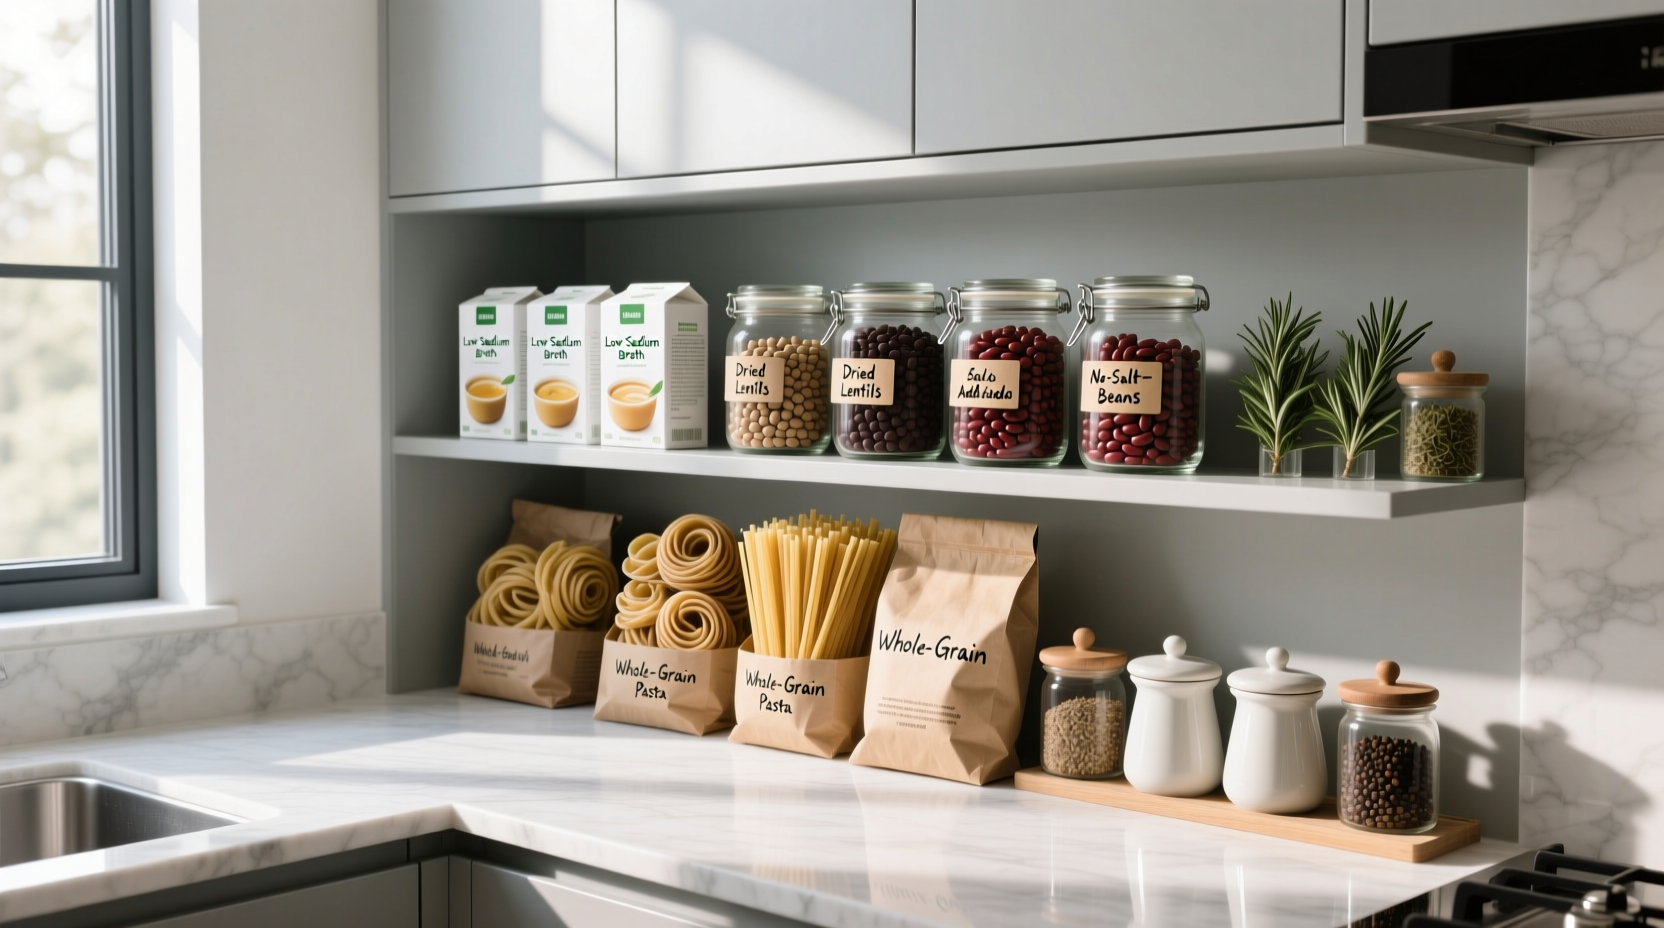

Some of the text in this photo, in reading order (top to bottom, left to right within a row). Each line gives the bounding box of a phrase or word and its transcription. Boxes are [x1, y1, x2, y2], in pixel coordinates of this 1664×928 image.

[605, 335, 623, 347] Low
[736, 362, 766, 378] Dried
[842, 363, 876, 380] Dried
[841, 382, 882, 399] Lentils
[1098, 387, 1141, 405] Beans
[879, 628, 987, 665] Whole-Grain
[615, 658, 697, 685] Whole-Grain
[634, 680, 667, 701] Pasta
[759, 692, 793, 715] Pasta
